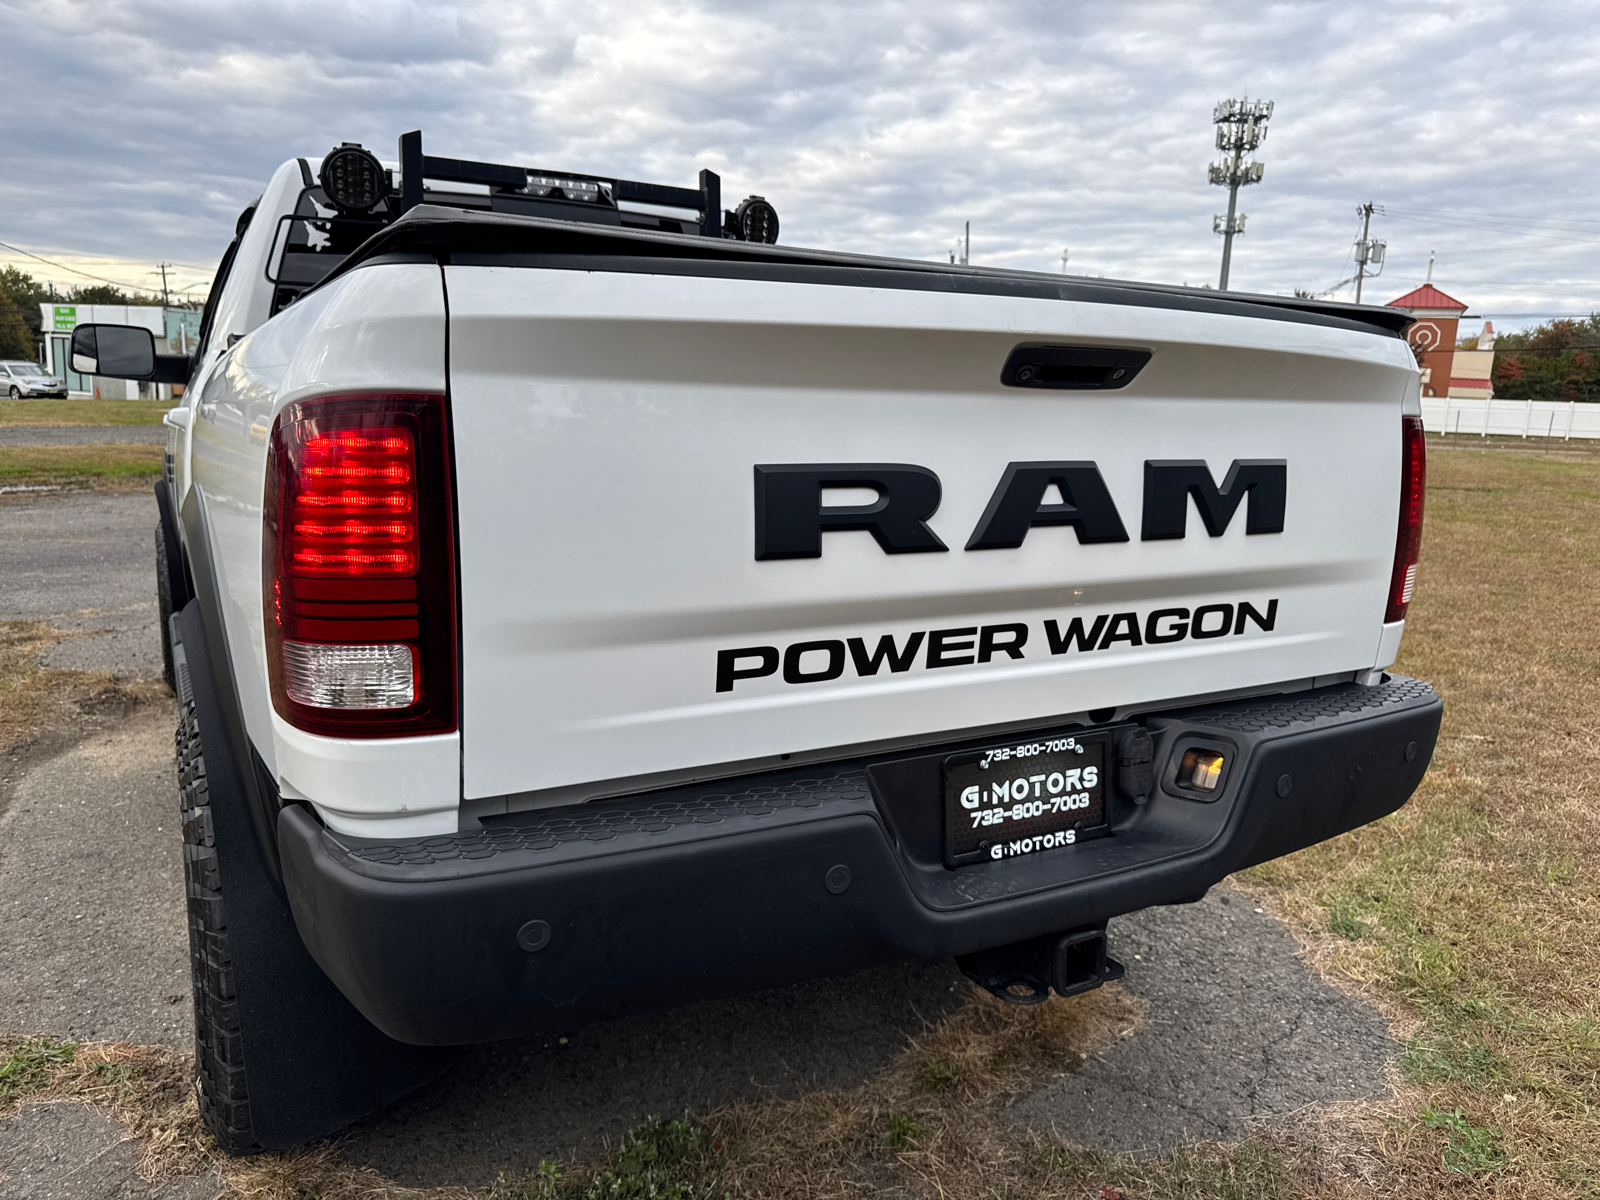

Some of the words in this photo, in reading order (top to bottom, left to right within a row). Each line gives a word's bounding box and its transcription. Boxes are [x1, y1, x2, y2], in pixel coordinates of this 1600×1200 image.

[754, 459, 1288, 562] RAM
[716, 623, 1029, 692] POWER
[1044, 599, 1279, 655] WAGON
[985, 738, 1075, 762] 732-800-7003
[970, 792, 1090, 829] 732-800-7003
